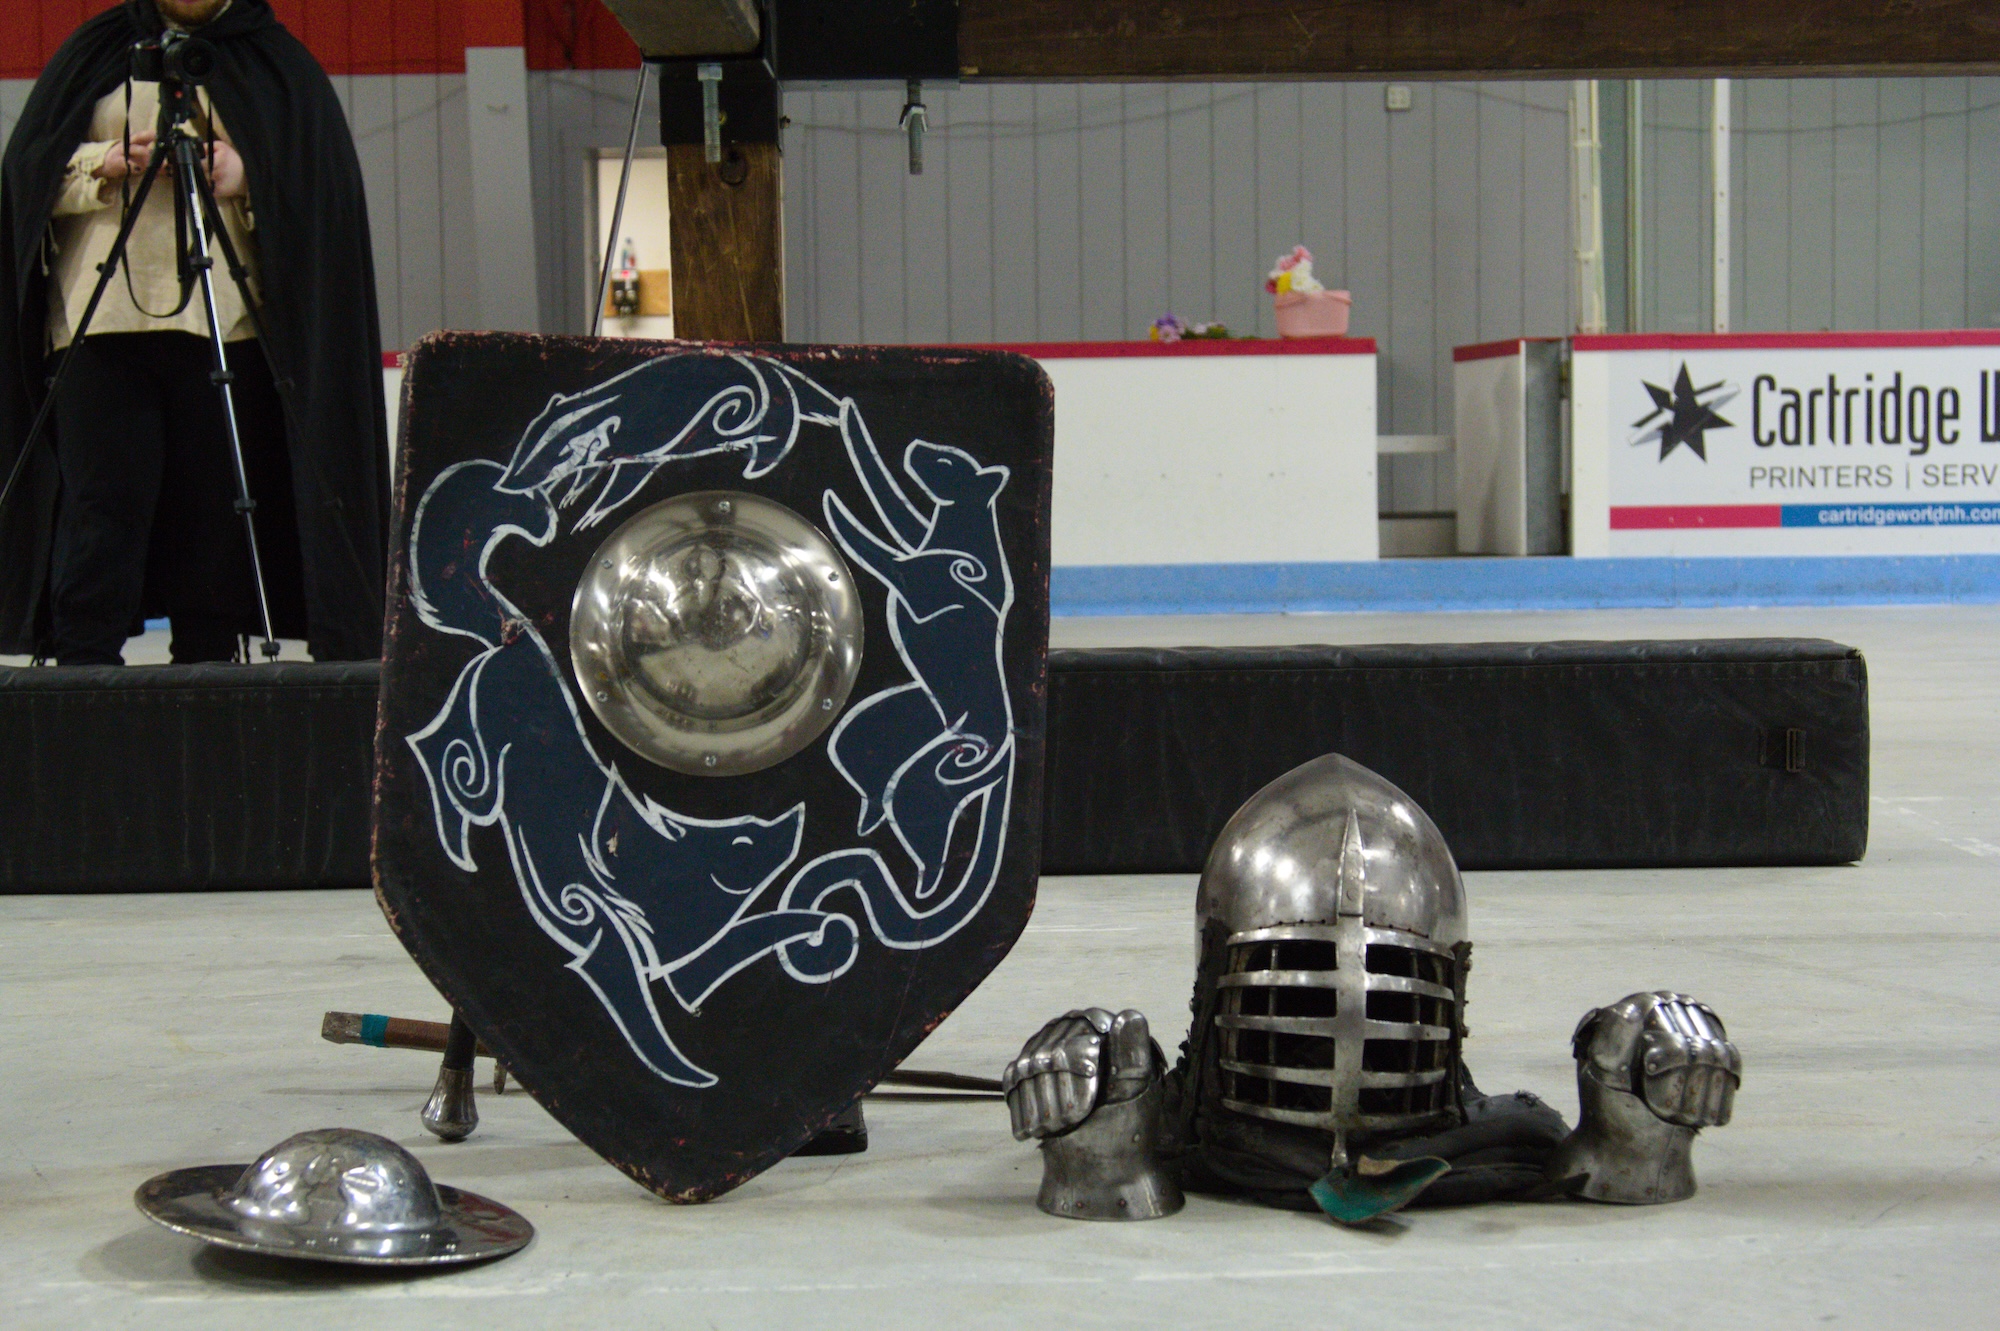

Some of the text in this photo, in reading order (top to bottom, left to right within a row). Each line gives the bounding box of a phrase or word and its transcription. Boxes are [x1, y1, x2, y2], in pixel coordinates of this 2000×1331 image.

[1753, 371, 1960, 456] Cartridge
[1750, 463, 1998, 488] PRINTERS SERV
